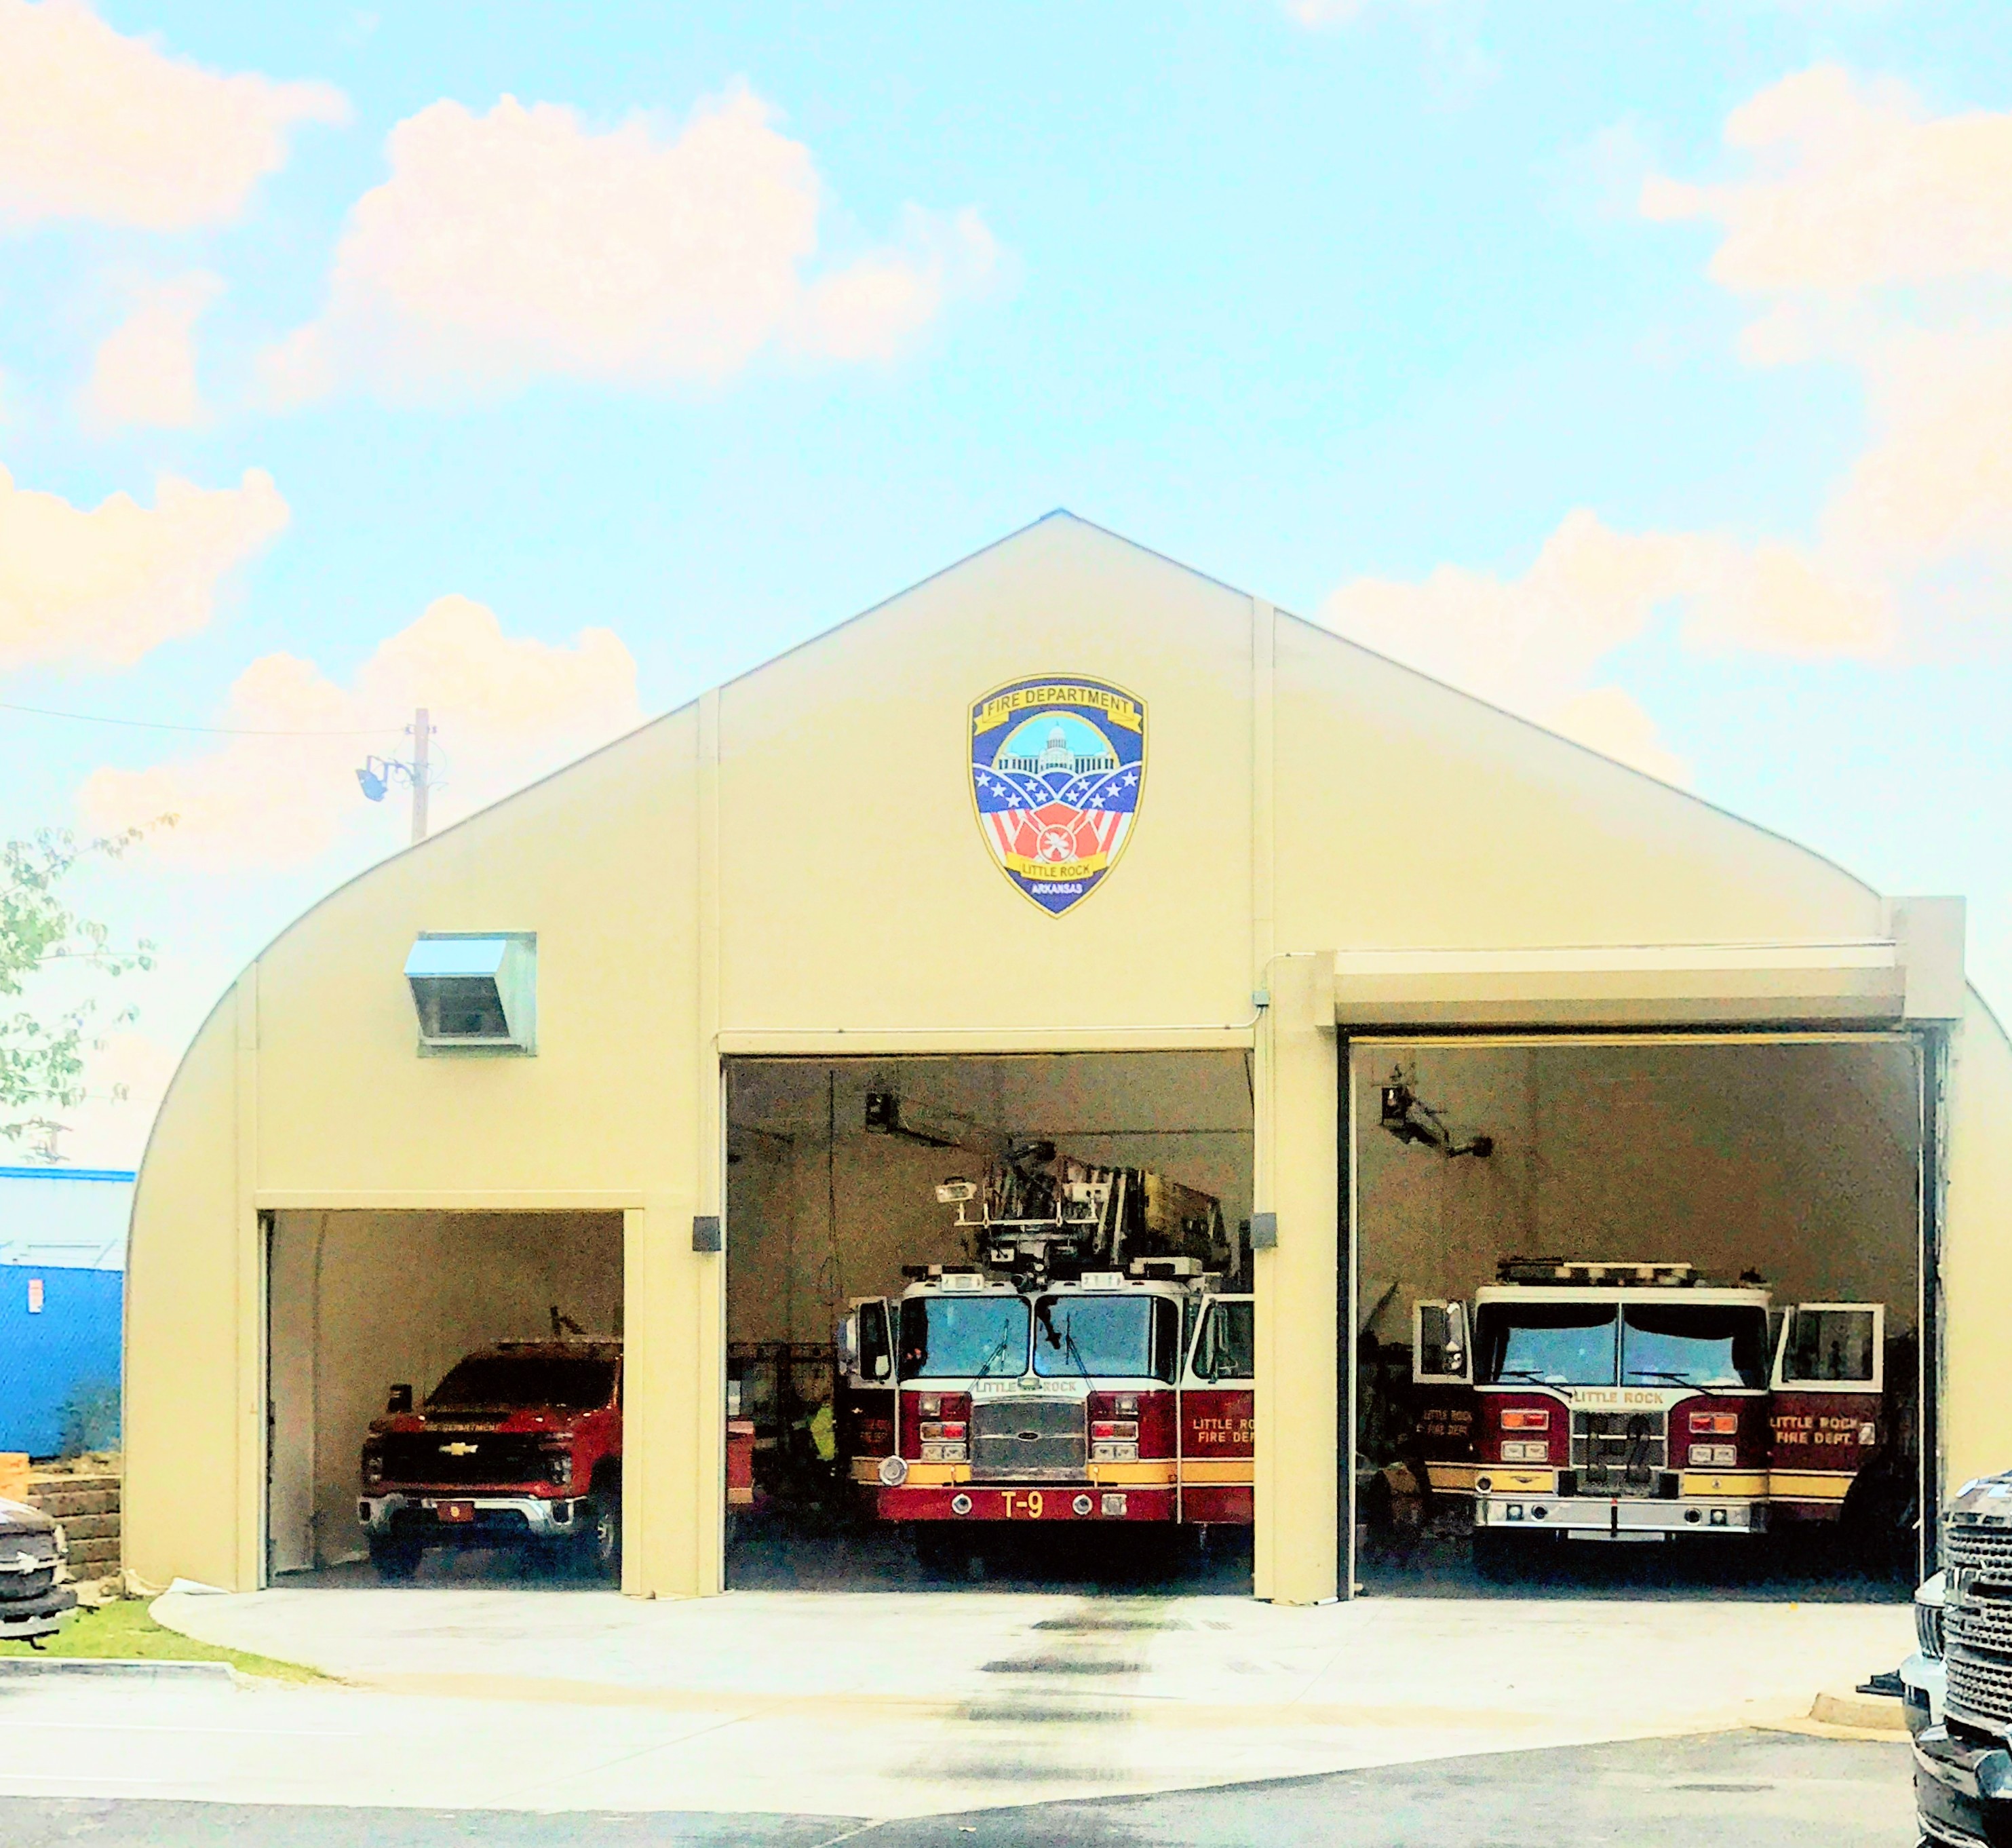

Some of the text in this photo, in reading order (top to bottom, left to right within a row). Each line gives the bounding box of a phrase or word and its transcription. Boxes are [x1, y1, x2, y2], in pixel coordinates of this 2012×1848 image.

[988, 688, 1129, 716] FIRE DEPARTMENT
[1022, 863, 1090, 877] LITTLE ROCK
[1032, 883, 1083, 894] ARKANSAS
[975, 1381, 1077, 1392] LITTLE ROCK
[1574, 1391, 1663, 1404] LITTLE ROCK
[1193, 1419, 1233, 1429] LITTLE
[1770, 1417, 1857, 1429] LITTLE ROCK
[1198, 1431, 1226, 1443] FIRE
[1777, 1431, 1807, 1444] FIRE
[1001, 1490, 1043, 1518] T-9
